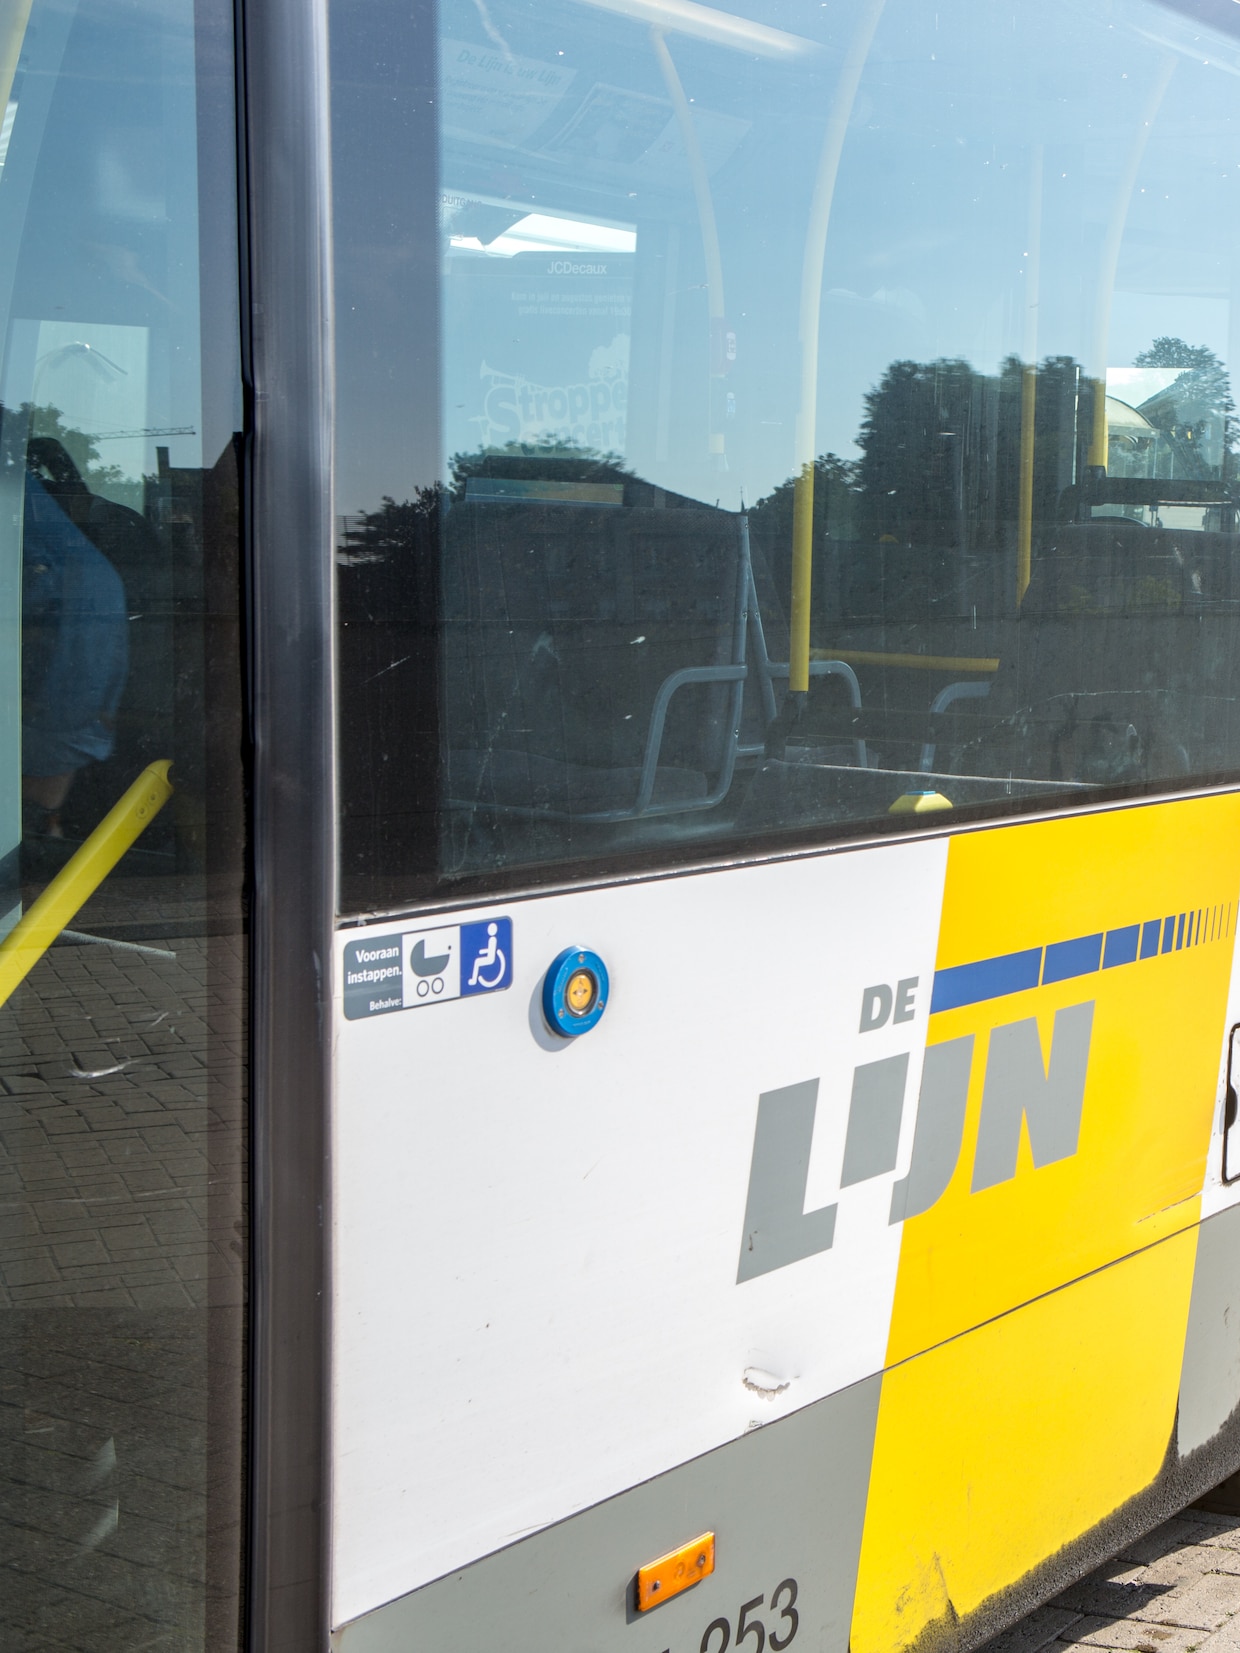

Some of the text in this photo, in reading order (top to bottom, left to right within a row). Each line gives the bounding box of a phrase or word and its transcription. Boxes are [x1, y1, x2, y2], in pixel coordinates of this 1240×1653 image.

[456, 48, 477, 65] De
[477, 54, 503, 73] Lijn
[537, 69, 562, 87] Lijn
[547, 260, 607, 276] JCDecaux
[355, 946, 399, 963] Vooraan
[347, 965, 402, 985] instappen.
[369, 997, 402, 1011] Behalve:
[859, 975, 919, 1034] DE
